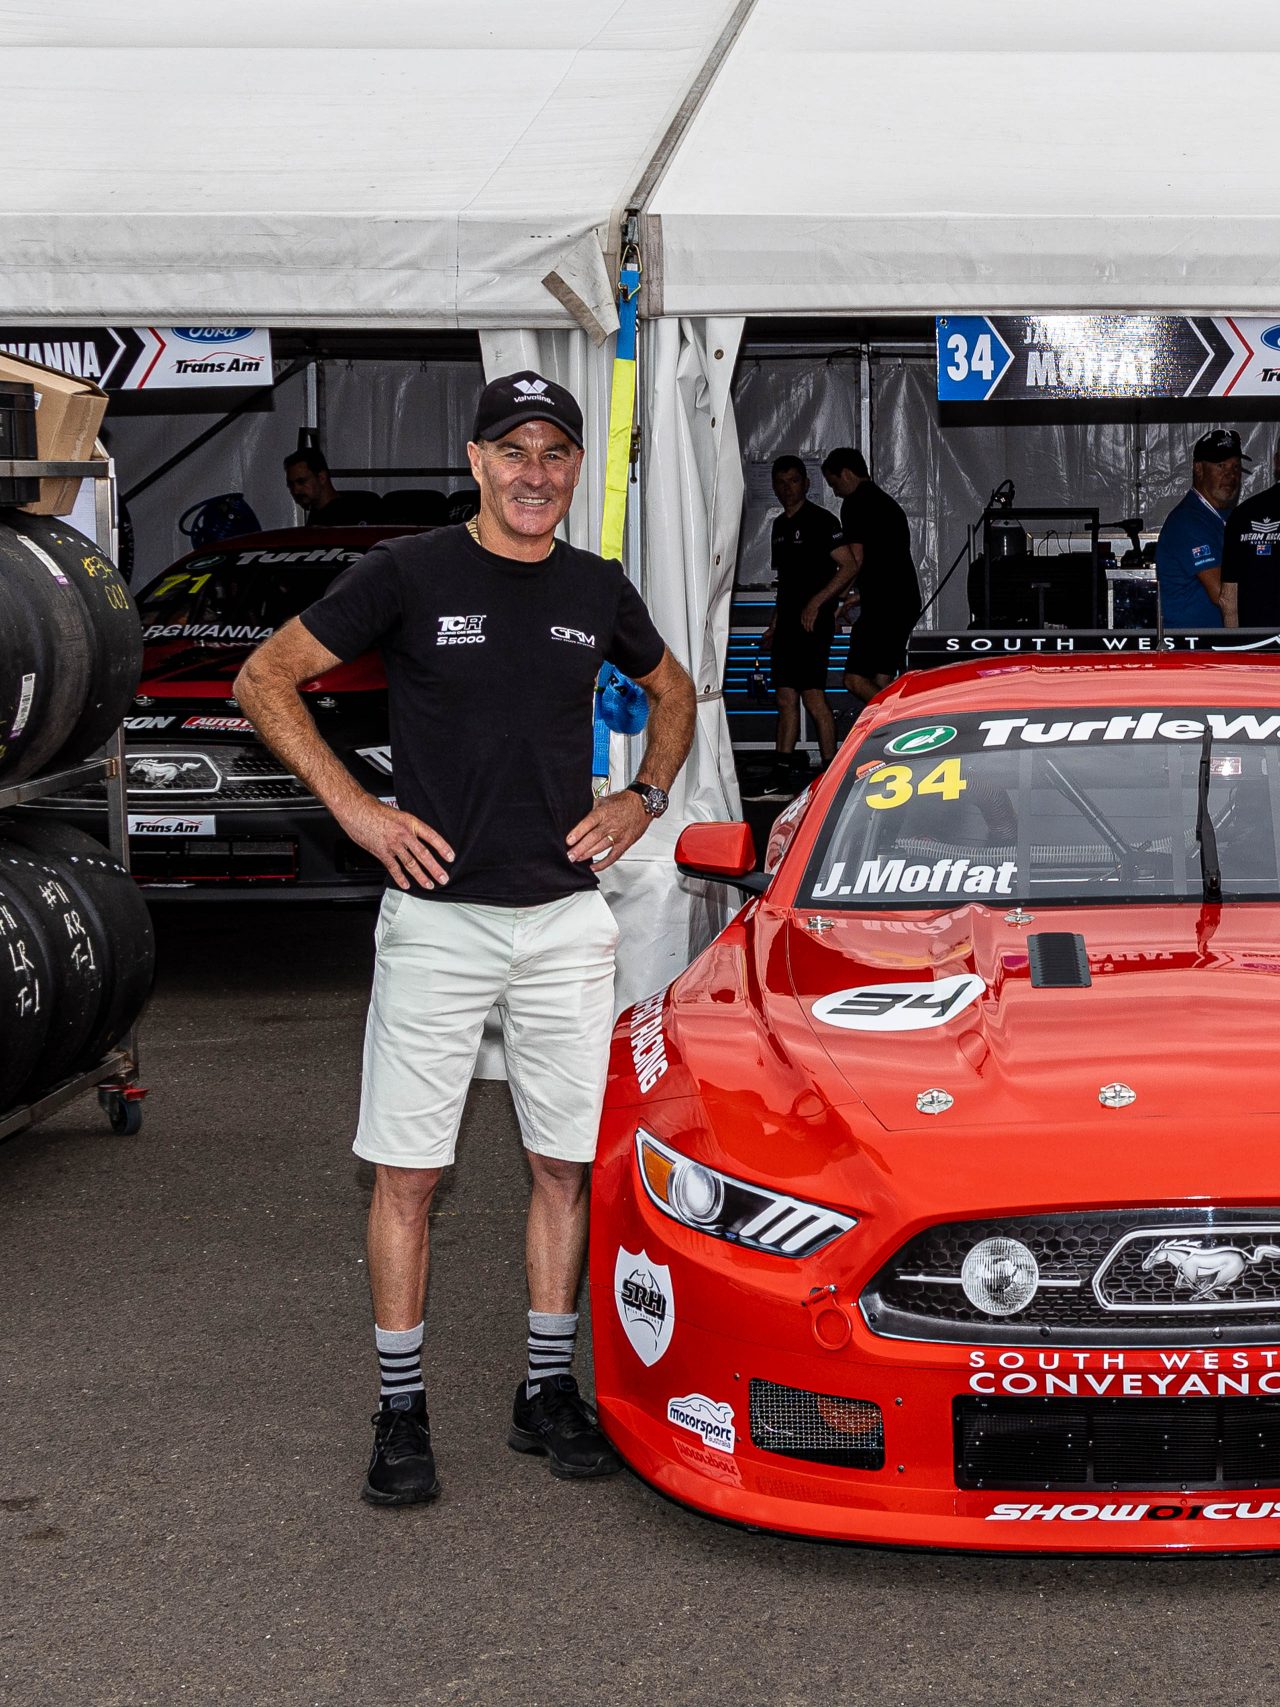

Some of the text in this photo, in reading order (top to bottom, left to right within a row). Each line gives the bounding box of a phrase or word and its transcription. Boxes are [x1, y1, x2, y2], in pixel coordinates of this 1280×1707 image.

[175, 357, 260, 374] Trans Am
[946, 334, 995, 381] 34
[514, 394, 552, 404] Valvoline
[154, 573, 212, 596] 71
[438, 615, 483, 632] TCR
[436, 635, 486, 646] S5000
[550, 626, 595, 646] GRM
[946, 637, 1199, 650] SOUTH WEST
[865, 758, 967, 810] 34
[134, 821, 200, 833] Trans Am
[812, 859, 1018, 898] J.Moffat
[630, 1014, 668, 1093] RACING
[968, 1351, 1278, 1369] SOUTH WEST
[669, 1407, 732, 1442] motorsport
